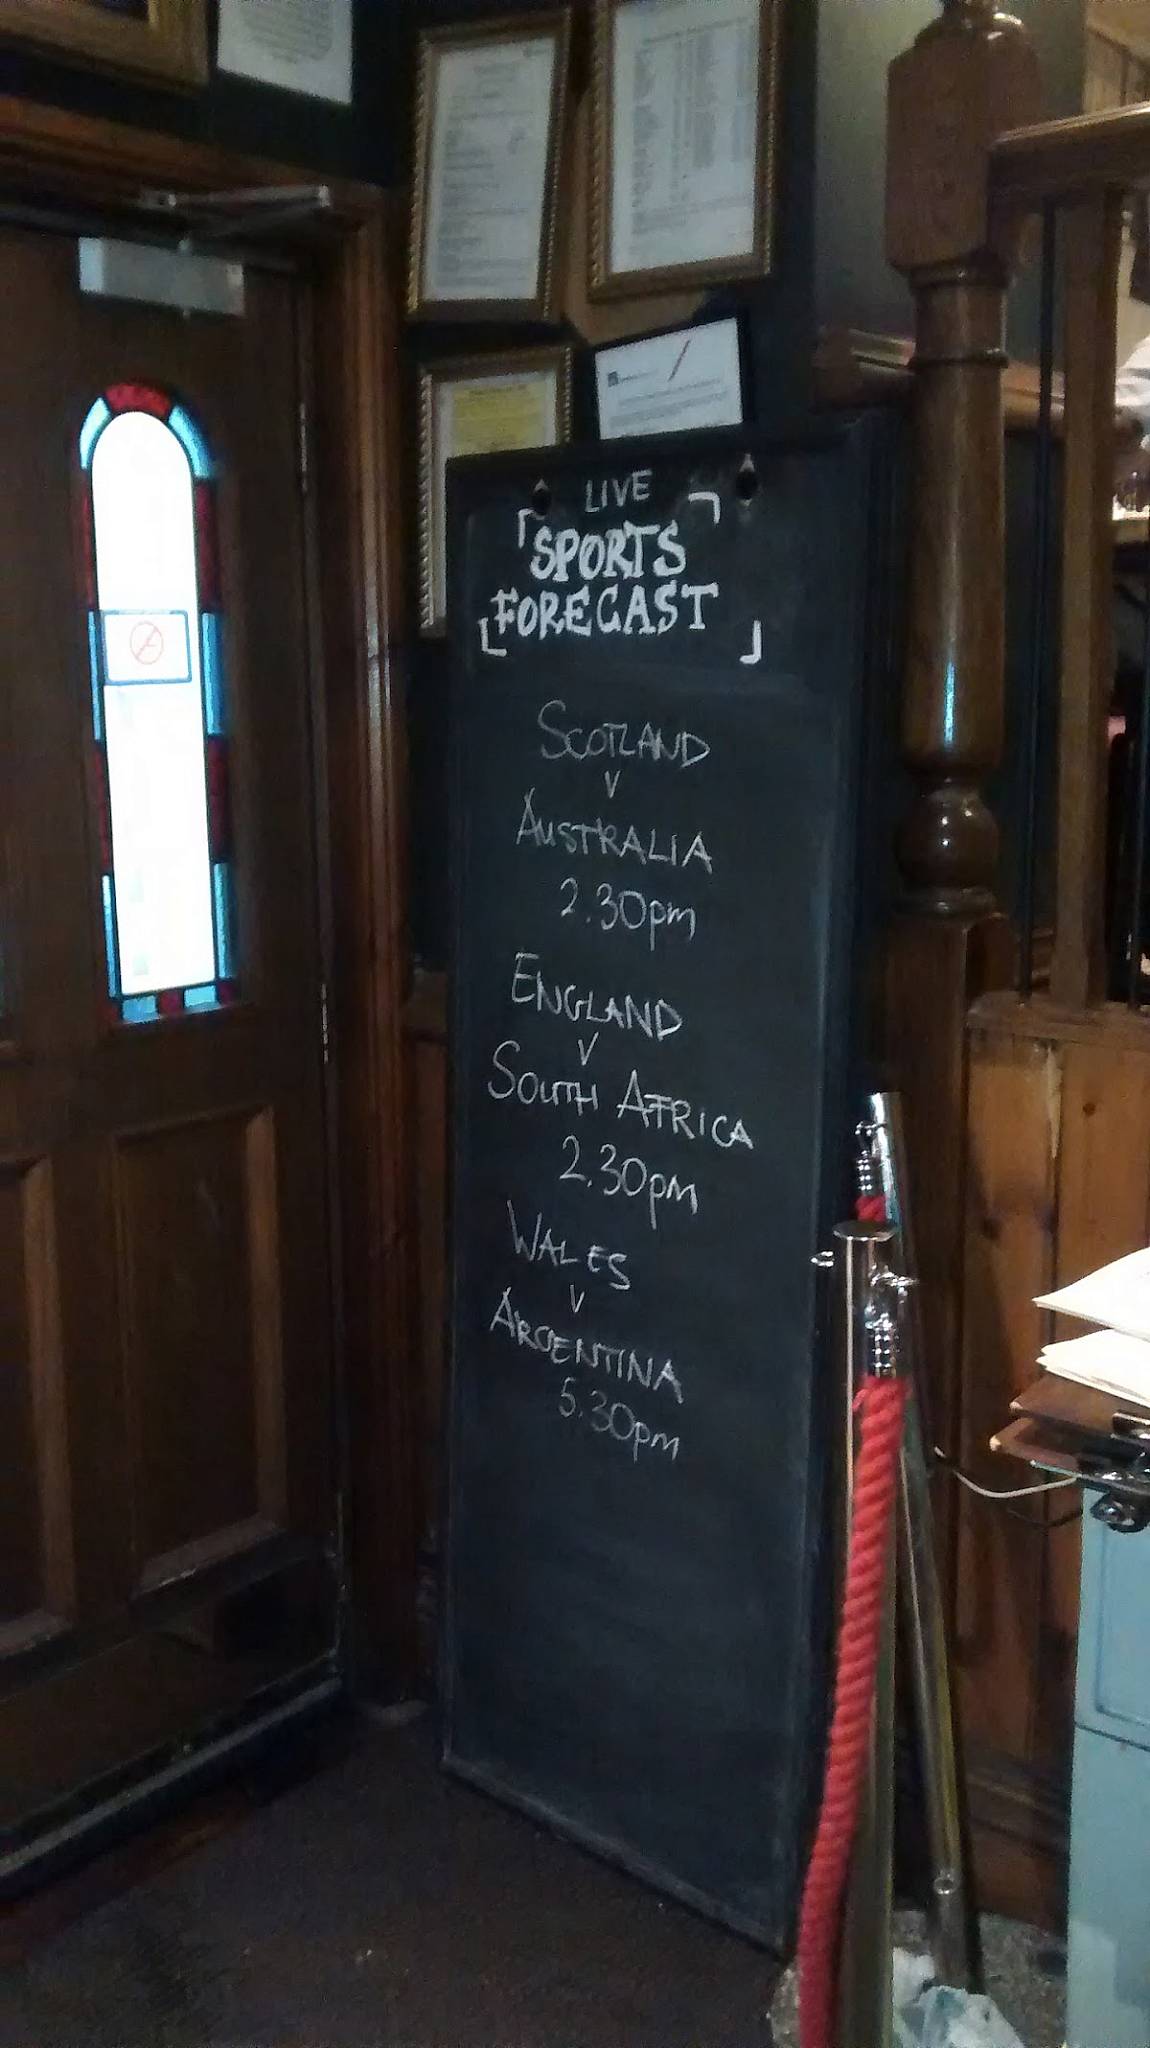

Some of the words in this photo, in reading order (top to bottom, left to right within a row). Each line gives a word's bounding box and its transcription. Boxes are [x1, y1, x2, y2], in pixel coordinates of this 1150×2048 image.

[585, 469, 653, 513] LIVE
[529, 520, 687, 582] SPORTS
[491, 582, 719, 639] FORECAST
[538, 700, 711, 768] SCOTLAND
[516, 787, 712, 874] AUSTRALIA
[561, 877, 696, 951] 2.30pm
[511, 952, 683, 1041] ENGLAND
[488, 1040, 598, 1116] SOUTH
[617, 1069, 754, 1150] AFRICA
[559, 1135, 699, 1230] 2.30pm
[507, 1200, 631, 1290] WALES
[489, 1287, 684, 1404] ARGENTINA
[559, 1376, 680, 1463] 5.30pm
